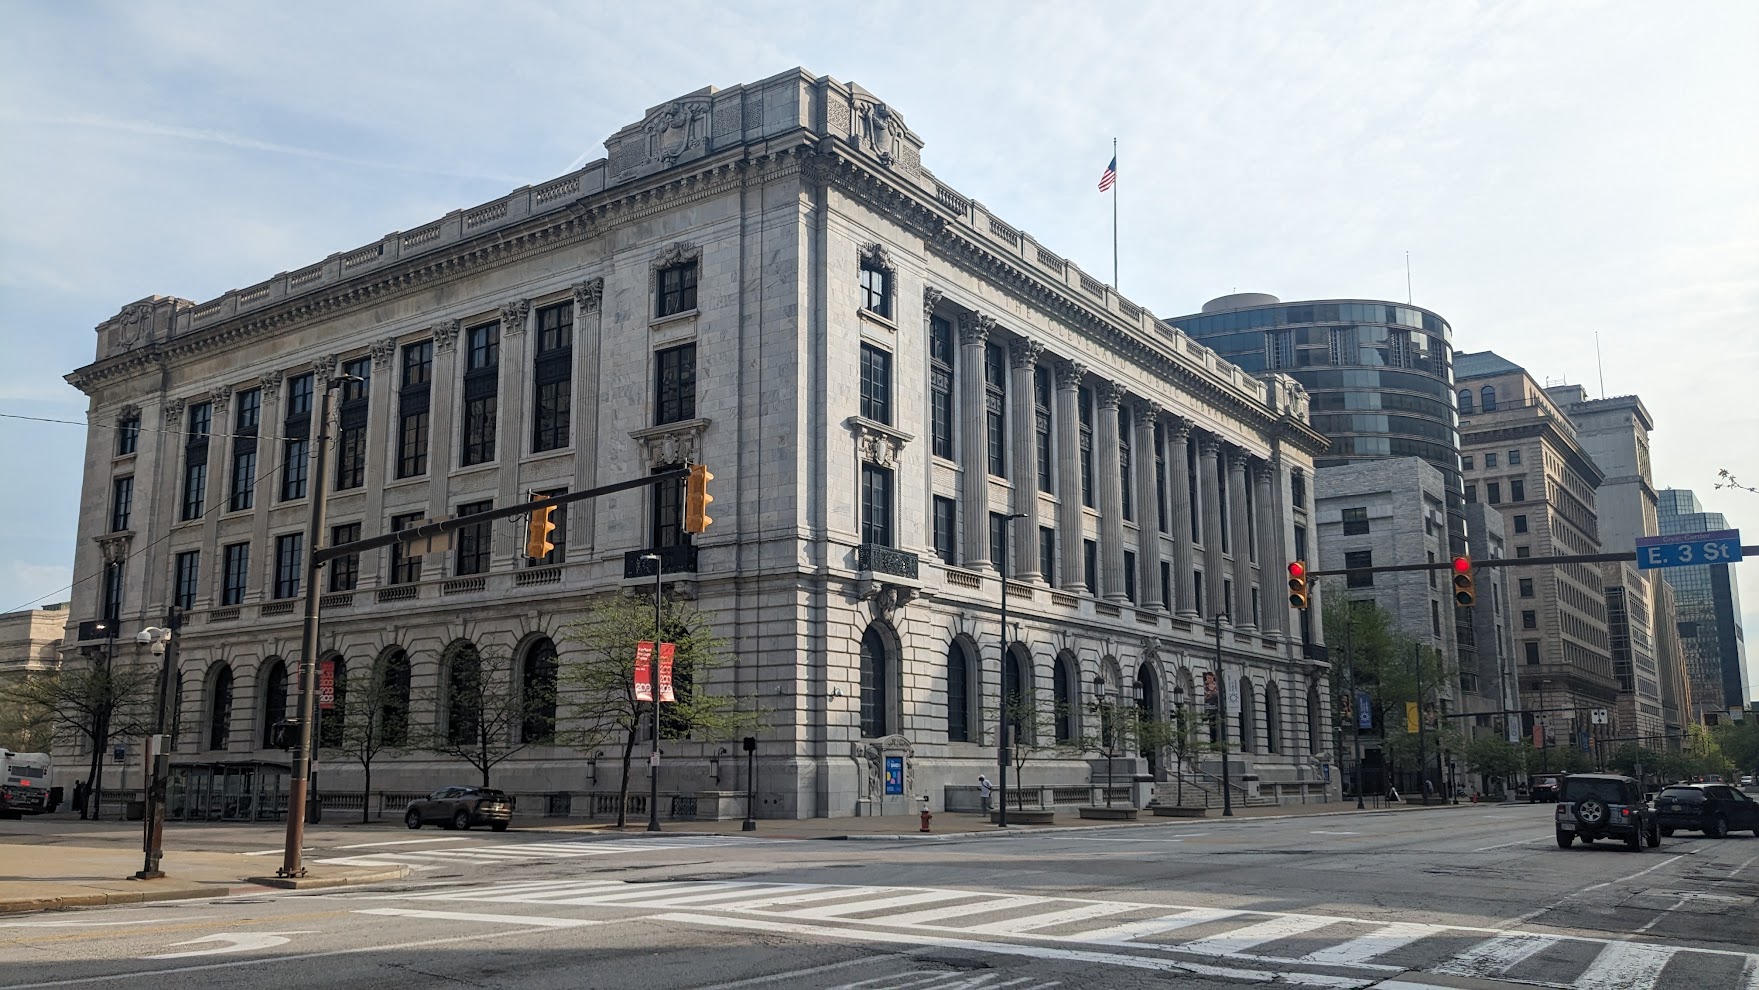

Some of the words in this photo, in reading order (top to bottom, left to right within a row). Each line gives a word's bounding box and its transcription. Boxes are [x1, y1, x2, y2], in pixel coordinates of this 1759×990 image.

[1005, 296, 1031, 319] THE
[1047, 318, 1126, 370] CLEVELAND
[1139, 368, 1179, 398] PUBLIC
[1684, 533, 1711, 541] Center
[1648, 546, 1668, 564] E.
[1678, 544, 1693, 562] 3
[1703, 542, 1730, 561] St
